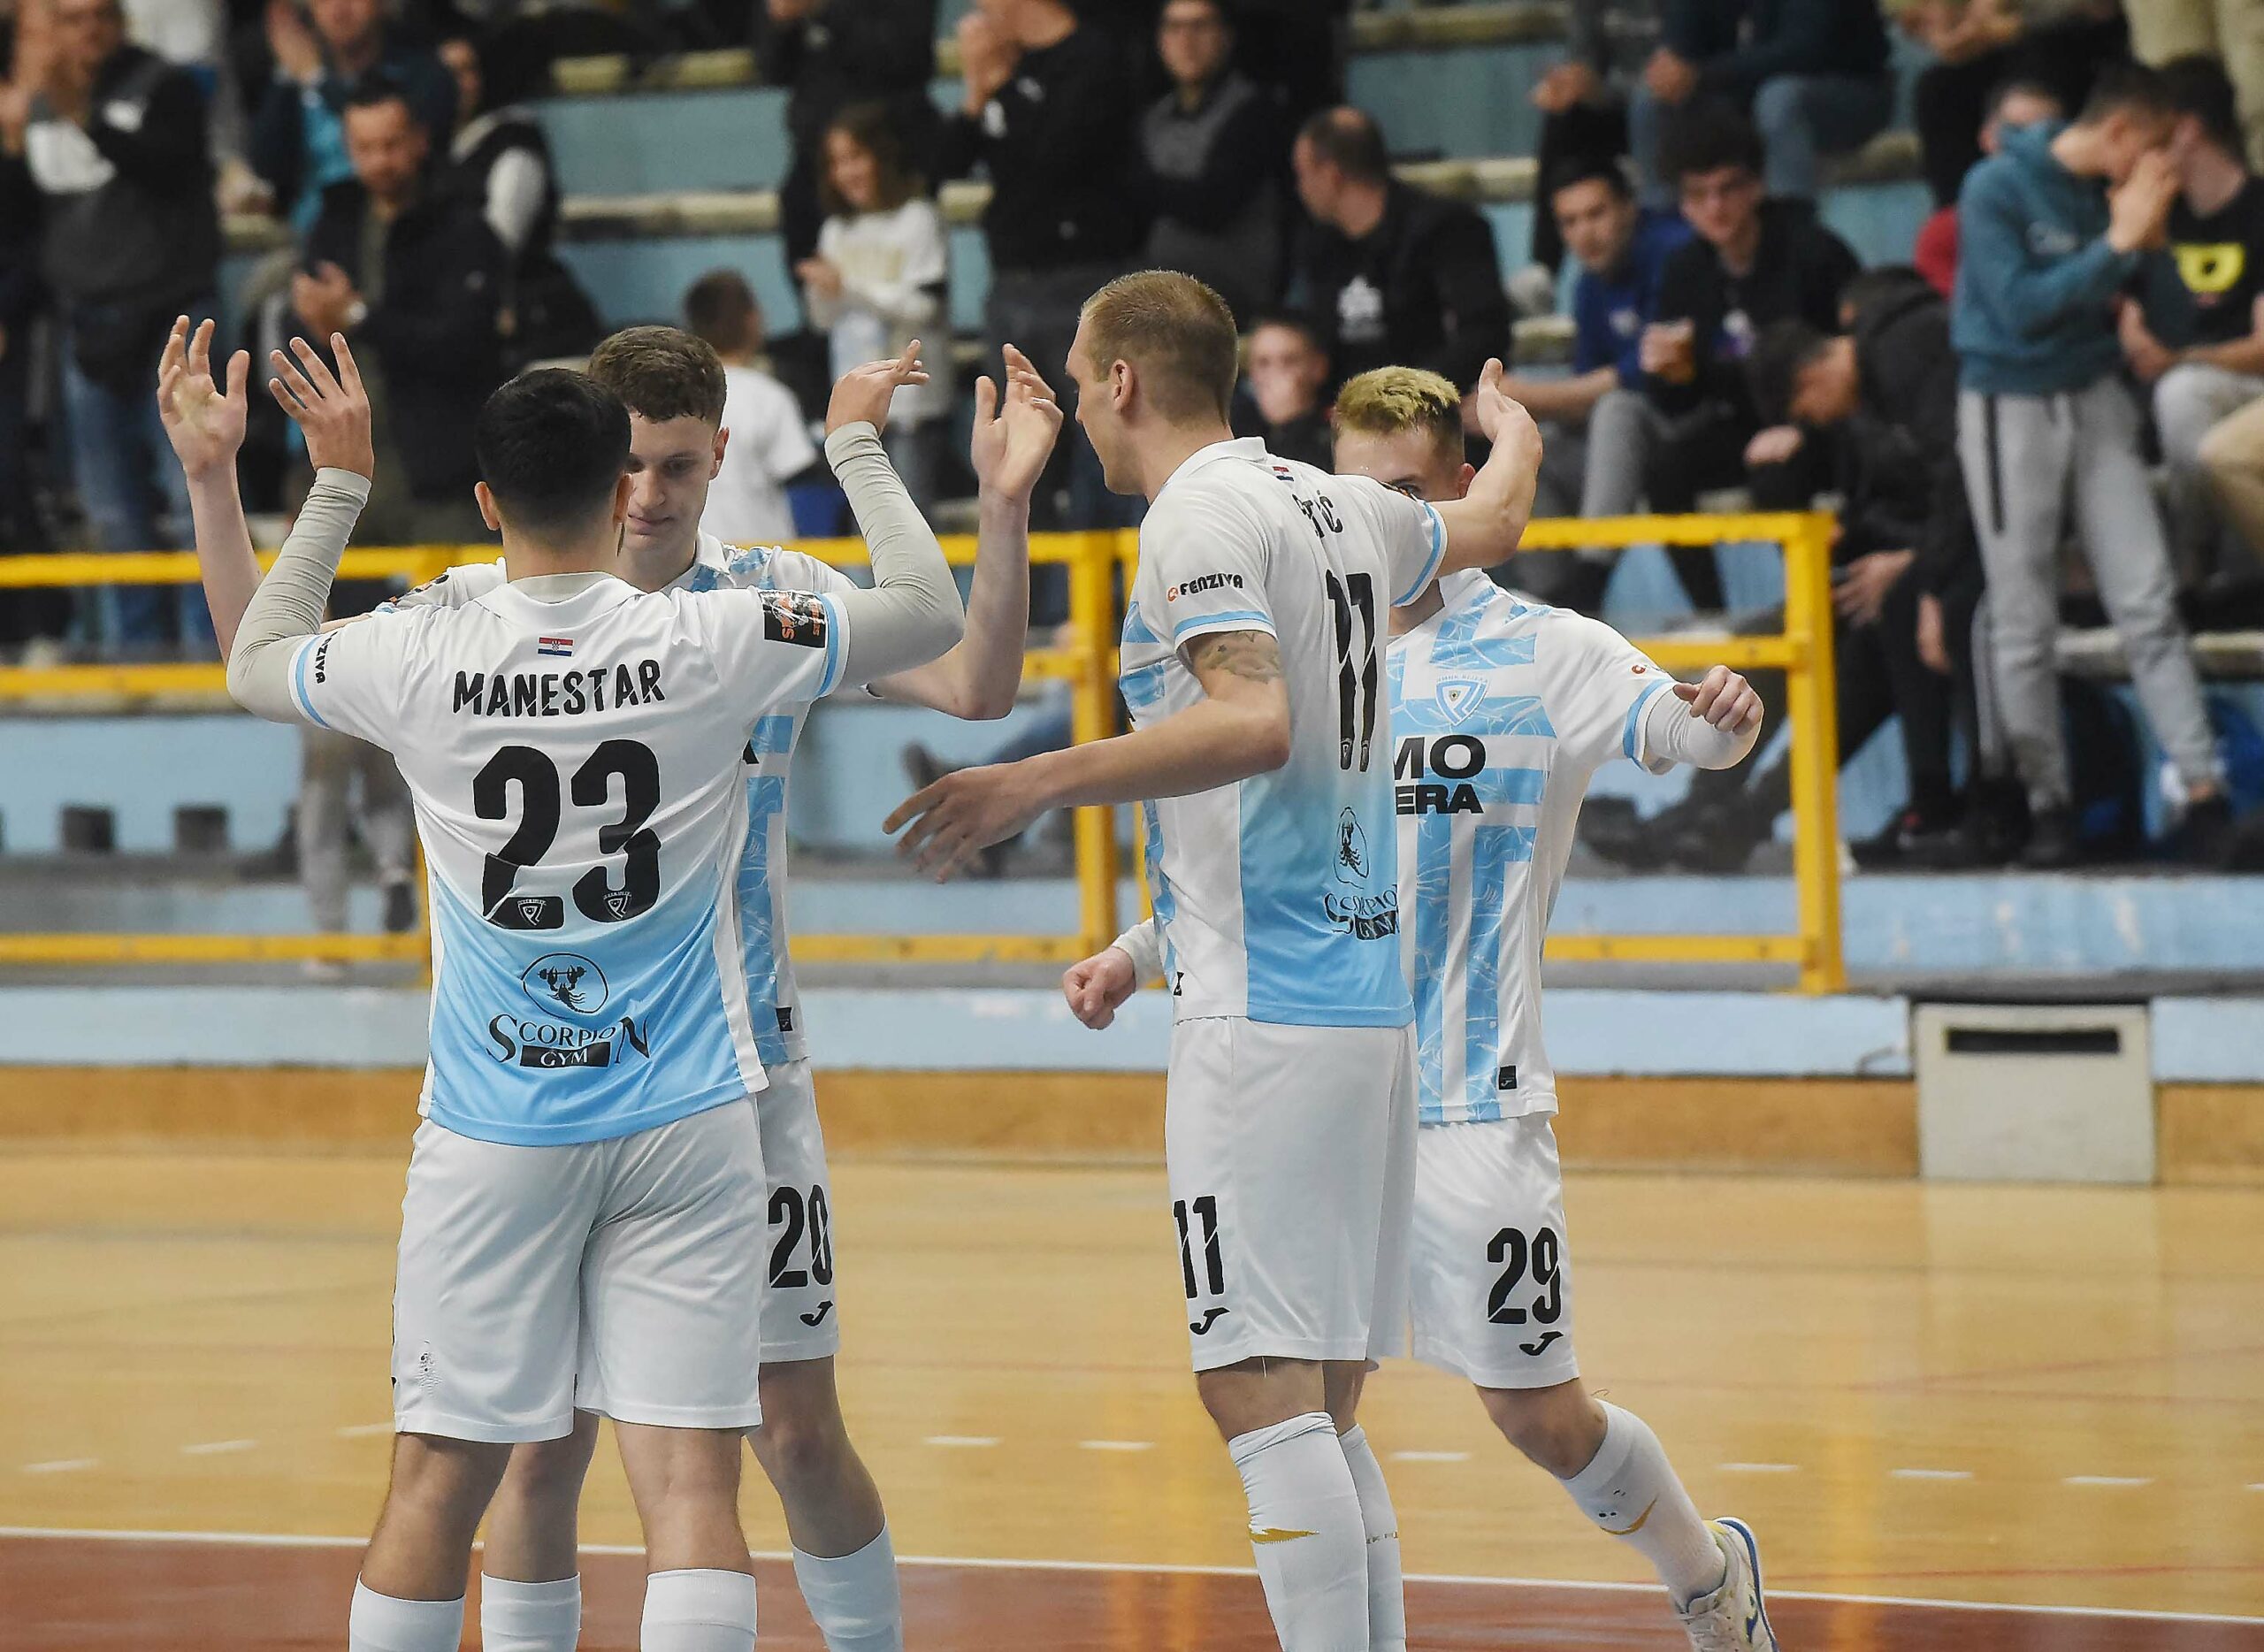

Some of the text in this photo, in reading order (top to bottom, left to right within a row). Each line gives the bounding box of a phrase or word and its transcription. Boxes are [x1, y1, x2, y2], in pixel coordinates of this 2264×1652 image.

[1179, 572, 1243, 596] FENZIVA
[453, 659, 666, 717] MANESTAR
[1326, 569, 1378, 772] 11
[1393, 734, 1487, 781] MO
[1395, 784, 1485, 815] ERA
[472, 739, 662, 930] 23
[1324, 884, 1400, 935] SCORPIO
[486, 1013, 650, 1064] SCORPION
[540, 1048, 588, 1067] GYM
[768, 1184, 833, 1289] 20
[1174, 1196, 1224, 1299] 11
[1488, 1227, 1561, 1325] 29
